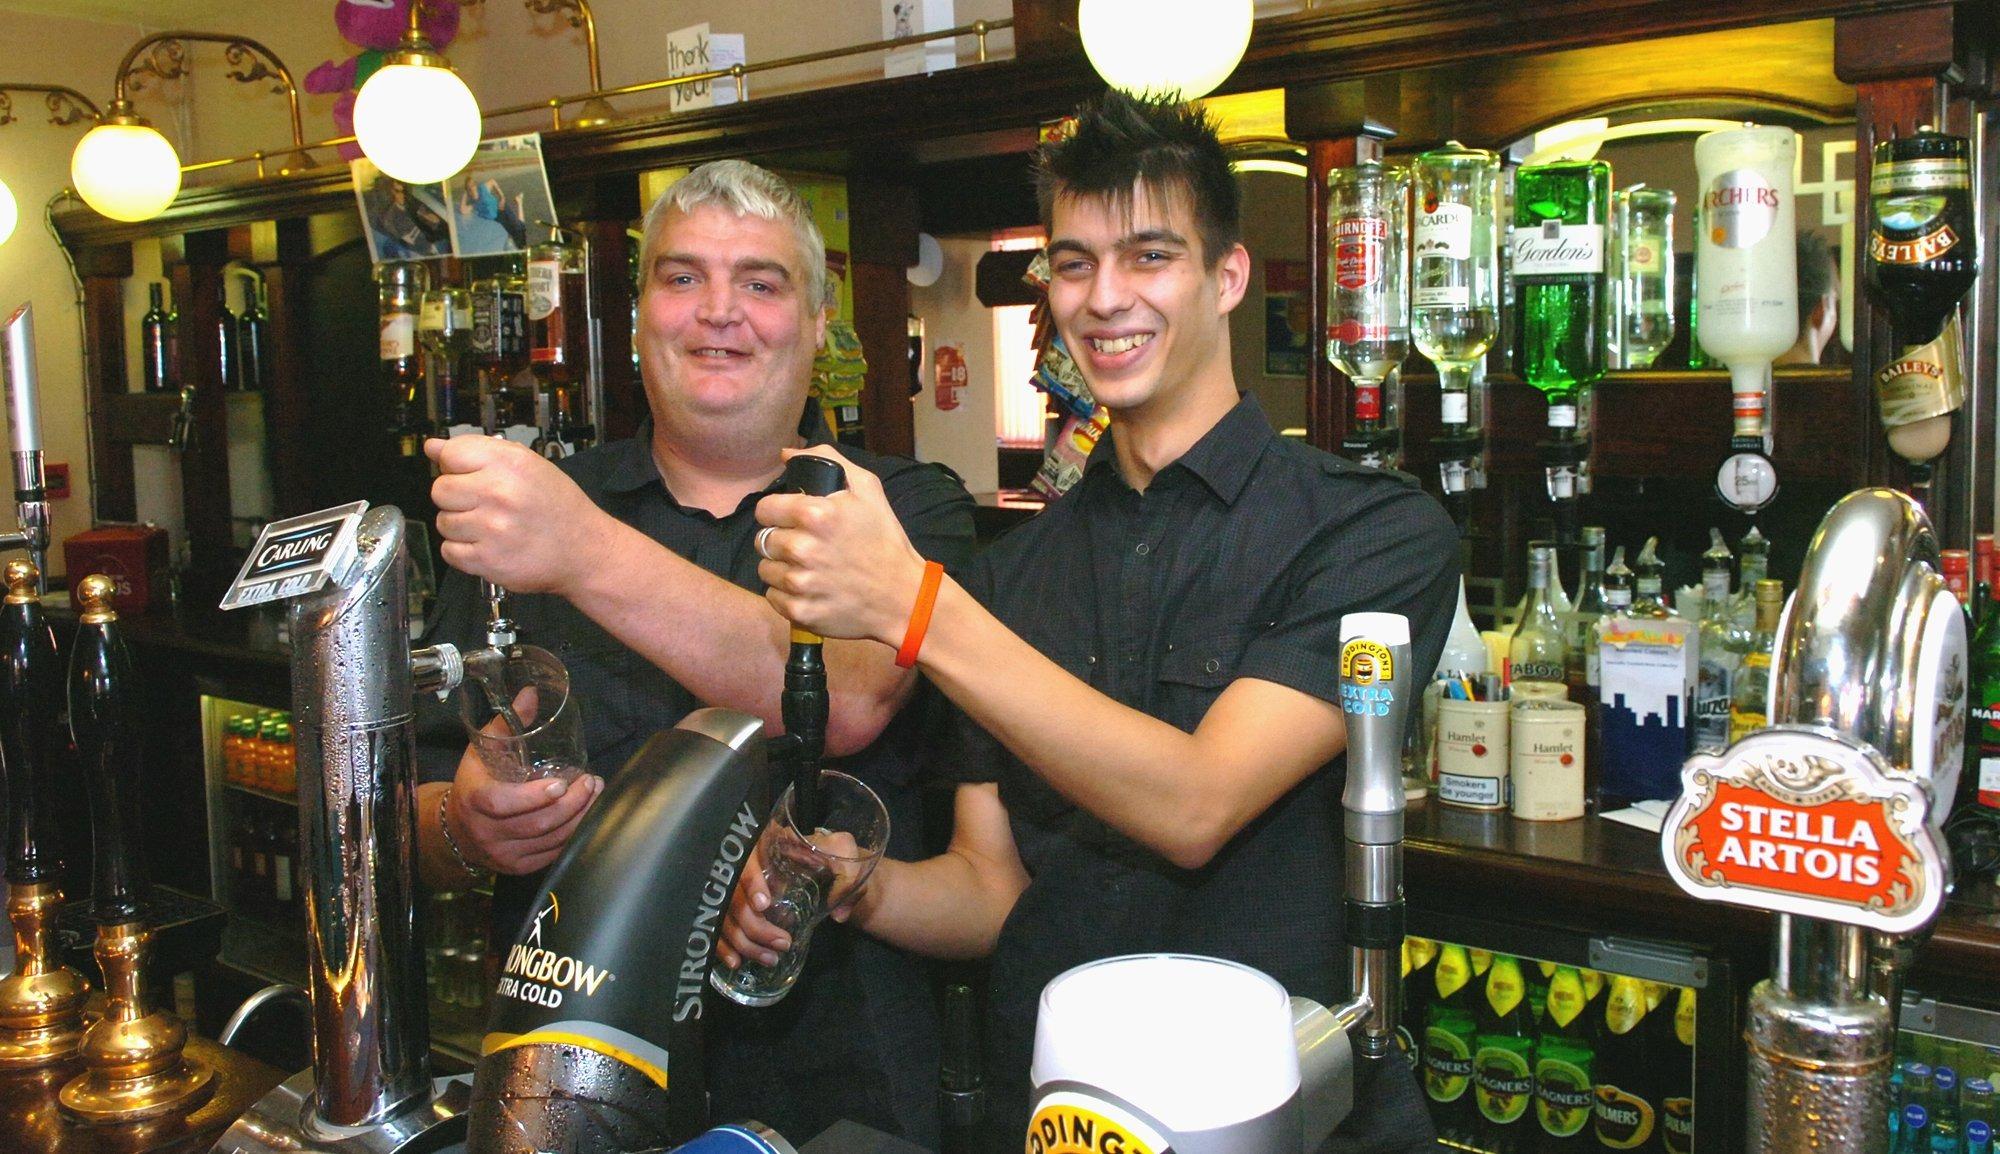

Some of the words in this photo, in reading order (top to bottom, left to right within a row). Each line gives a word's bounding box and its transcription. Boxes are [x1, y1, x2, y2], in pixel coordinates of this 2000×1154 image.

[1516, 238, 1594, 264] Gordon's
[1871, 230, 1953, 260] BAILEYS
[1881, 361, 1940, 382] BAILEYS
[257, 532, 332, 568] CARLING
[239, 582, 275, 598] EXTRA
[278, 574, 311, 594] COLD
[1509, 663, 1562, 678] ABOO
[1340, 683, 1394, 701] EXTRA
[1343, 699, 1390, 717] COLD
[1448, 731, 1486, 744] Hamlet
[1533, 742, 1573, 754] Hamlet
[1445, 777, 1487, 790] Smokers
[1455, 788, 1494, 801] younger
[1720, 802, 1880, 851] STELLA
[1717, 836, 1880, 886] ARTOIS
[672, 801, 760, 1022] STRONGBOW
[520, 982, 563, 1009] COLD
